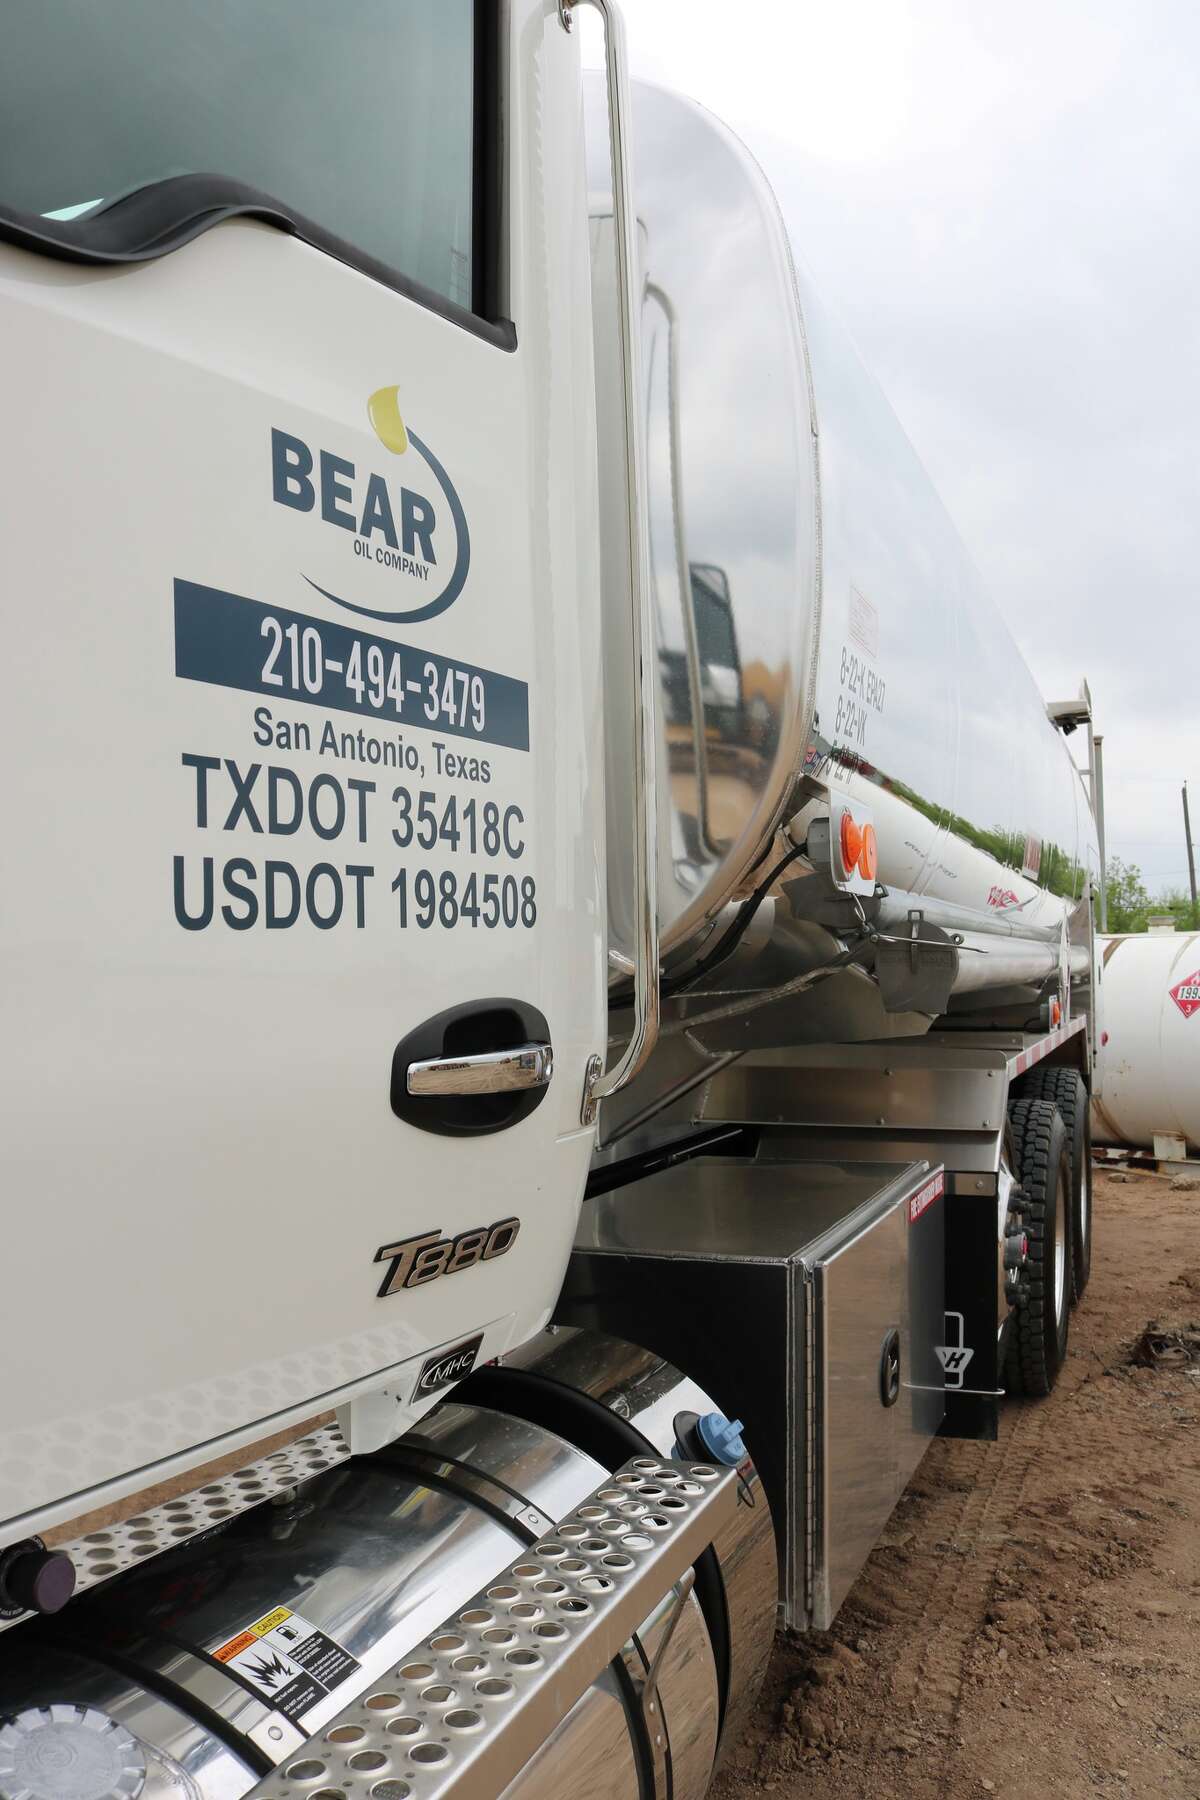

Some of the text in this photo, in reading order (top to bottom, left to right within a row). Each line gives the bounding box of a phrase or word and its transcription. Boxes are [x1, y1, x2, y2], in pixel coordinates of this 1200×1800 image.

[271, 426, 438, 565] BEAR
[354, 539, 429, 581] OIL COMPANY
[260, 616, 485, 732] 210-494-3479
[253, 706, 491, 783] San Antonio, Texas
[182, 753, 525, 859] TXDOT 35418C
[173, 855, 537, 931] USDOT 1984508
[374, 1216, 521, 1298] T880
[432, 1350, 476, 1383] MHC
[224, 1634, 254, 1657] WARNING
[256, 1612, 285, 1632] CAUTION
